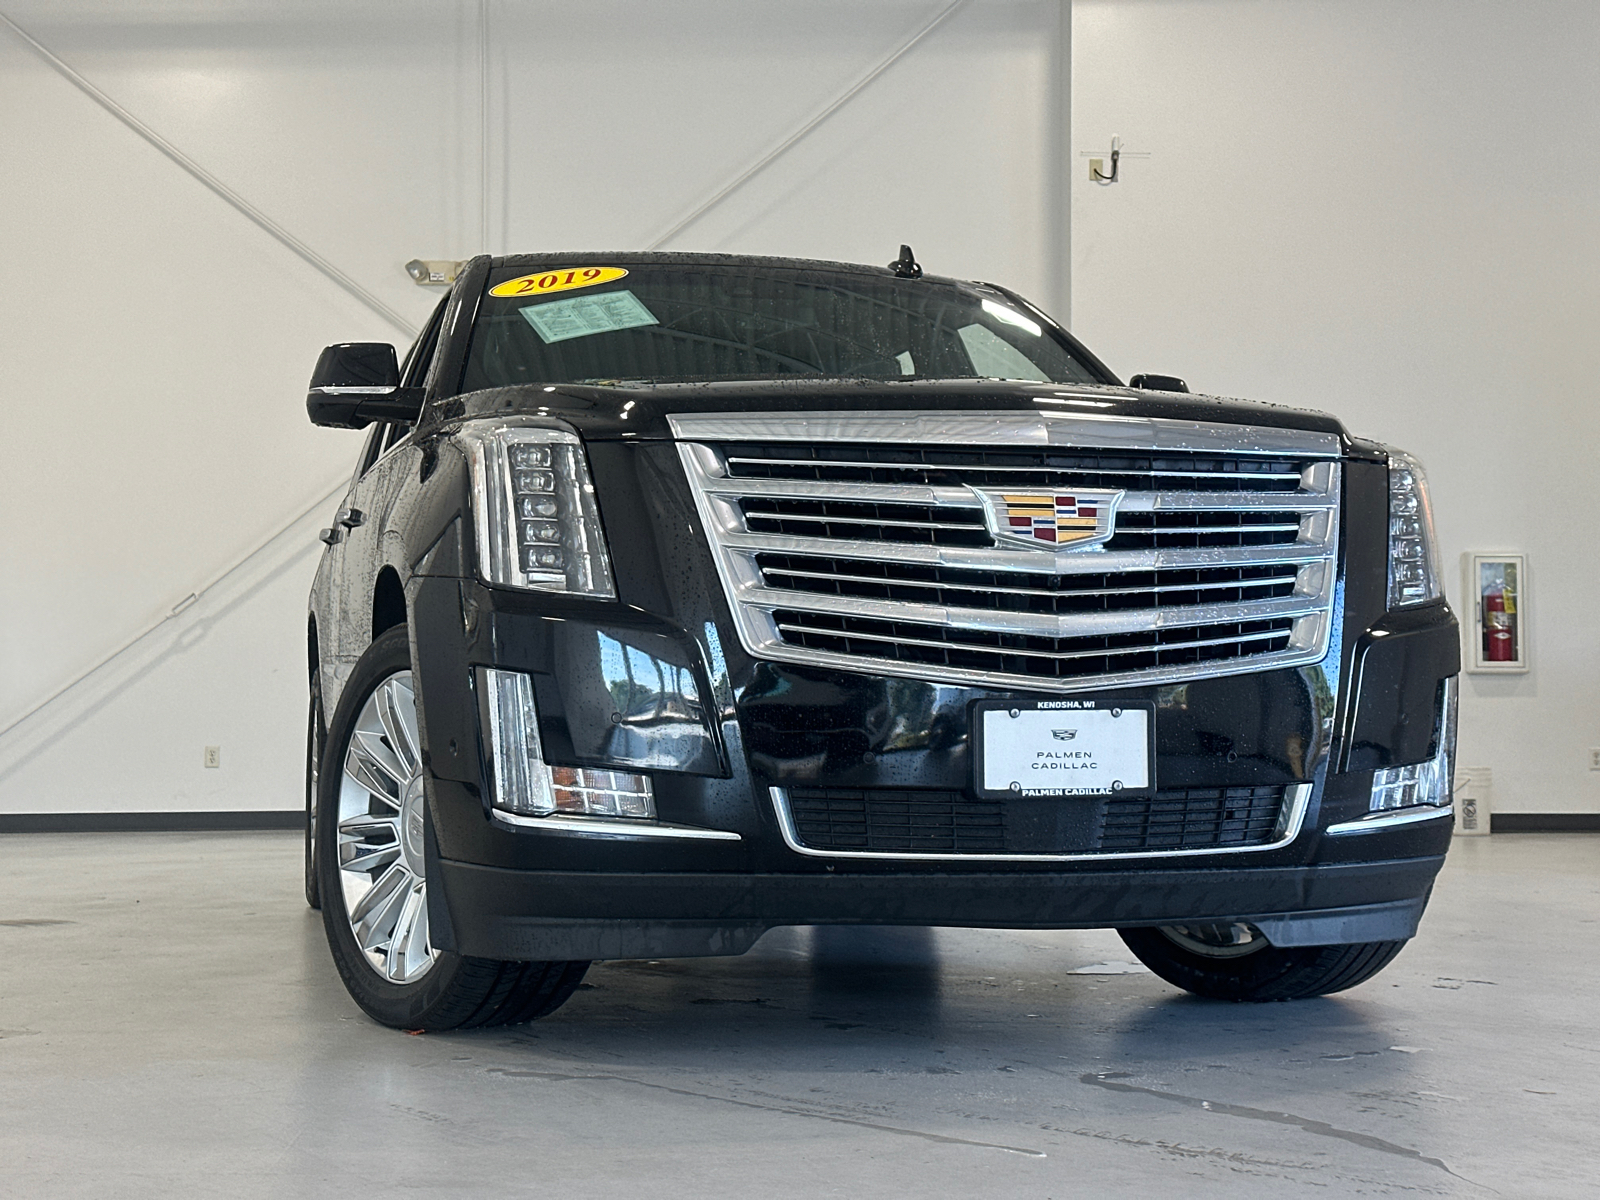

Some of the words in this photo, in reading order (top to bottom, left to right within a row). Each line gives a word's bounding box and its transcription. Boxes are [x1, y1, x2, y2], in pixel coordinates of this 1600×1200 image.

[516, 269, 601, 293] 2019
[1037, 701, 1082, 709] KENOSHA,
[1036, 751, 1092, 759] PALMEN
[1031, 762, 1098, 770] CADILLAC
[1022, 788, 1063, 797] PALMEN
[1064, 787, 1113, 796] CADILLAC
